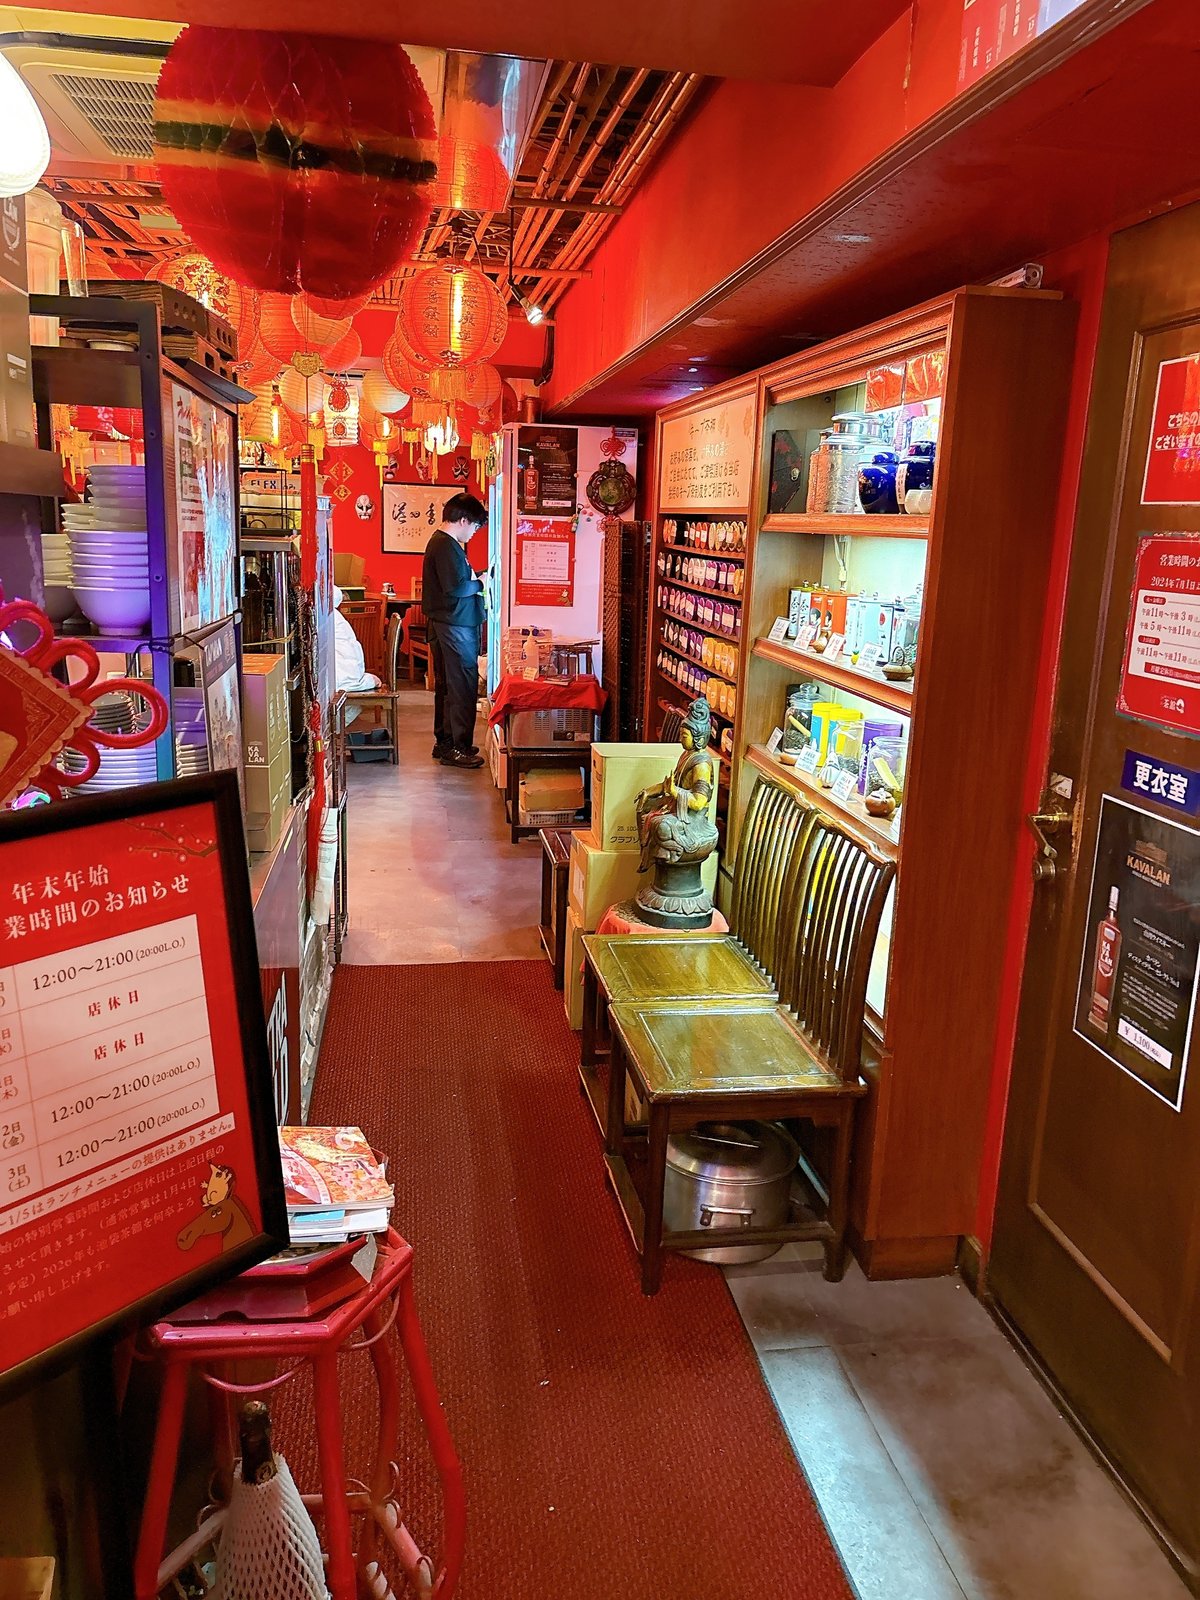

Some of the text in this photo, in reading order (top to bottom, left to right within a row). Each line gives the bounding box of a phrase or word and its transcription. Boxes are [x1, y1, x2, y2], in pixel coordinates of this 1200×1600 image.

[1167, 411, 1200, 428] こちらの
[1133, 760, 1188, 804] 更衣室
[11, 864, 110, 905] 年末年始
[1126, 855, 1171, 885] KAVALAN
[4, 873, 190, 940] 業時間のお知らせ
[87, 989, 140, 1017] 店休日
[93, 1032, 145, 1061] 店休日
[8, 1164, 27, 1180] 3日
